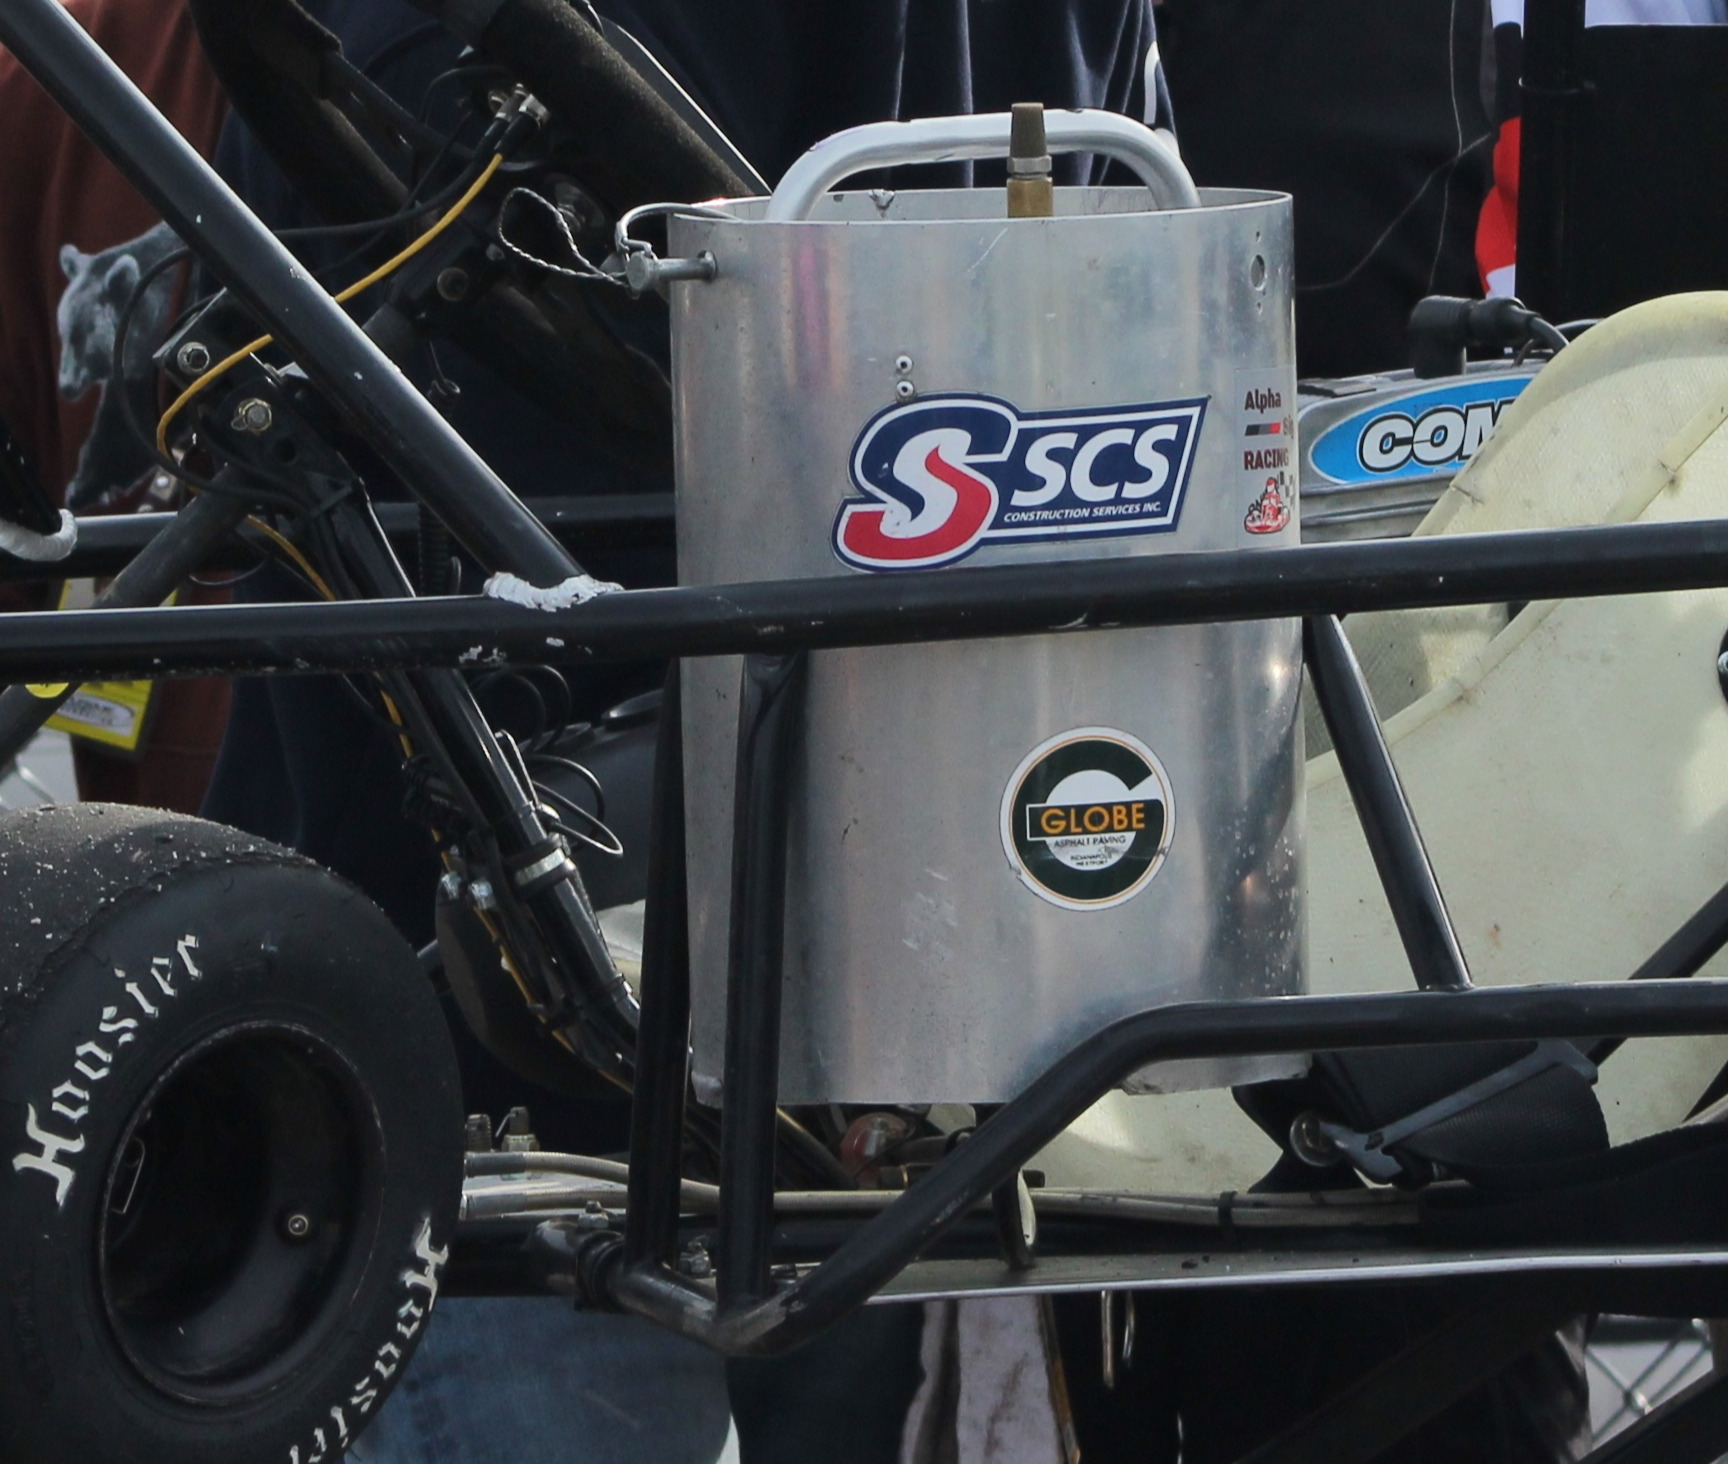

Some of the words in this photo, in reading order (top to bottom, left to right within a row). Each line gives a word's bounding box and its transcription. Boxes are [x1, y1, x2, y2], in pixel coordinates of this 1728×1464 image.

[1244, 387, 1281, 414] Alpha
[1010, 423, 1179, 507] SCS
[1243, 447, 1289, 470] RACING
[1004, 507, 1090, 523] CONSTRUCTION
[1092, 502, 1140, 517] SERVICES
[1142, 501, 1162, 513] INC.
[1040, 802, 1146, 834] GLOBE
[1054, 837, 1090, 848] ASPHALT
[12, 934, 203, 1209] Hoosier
